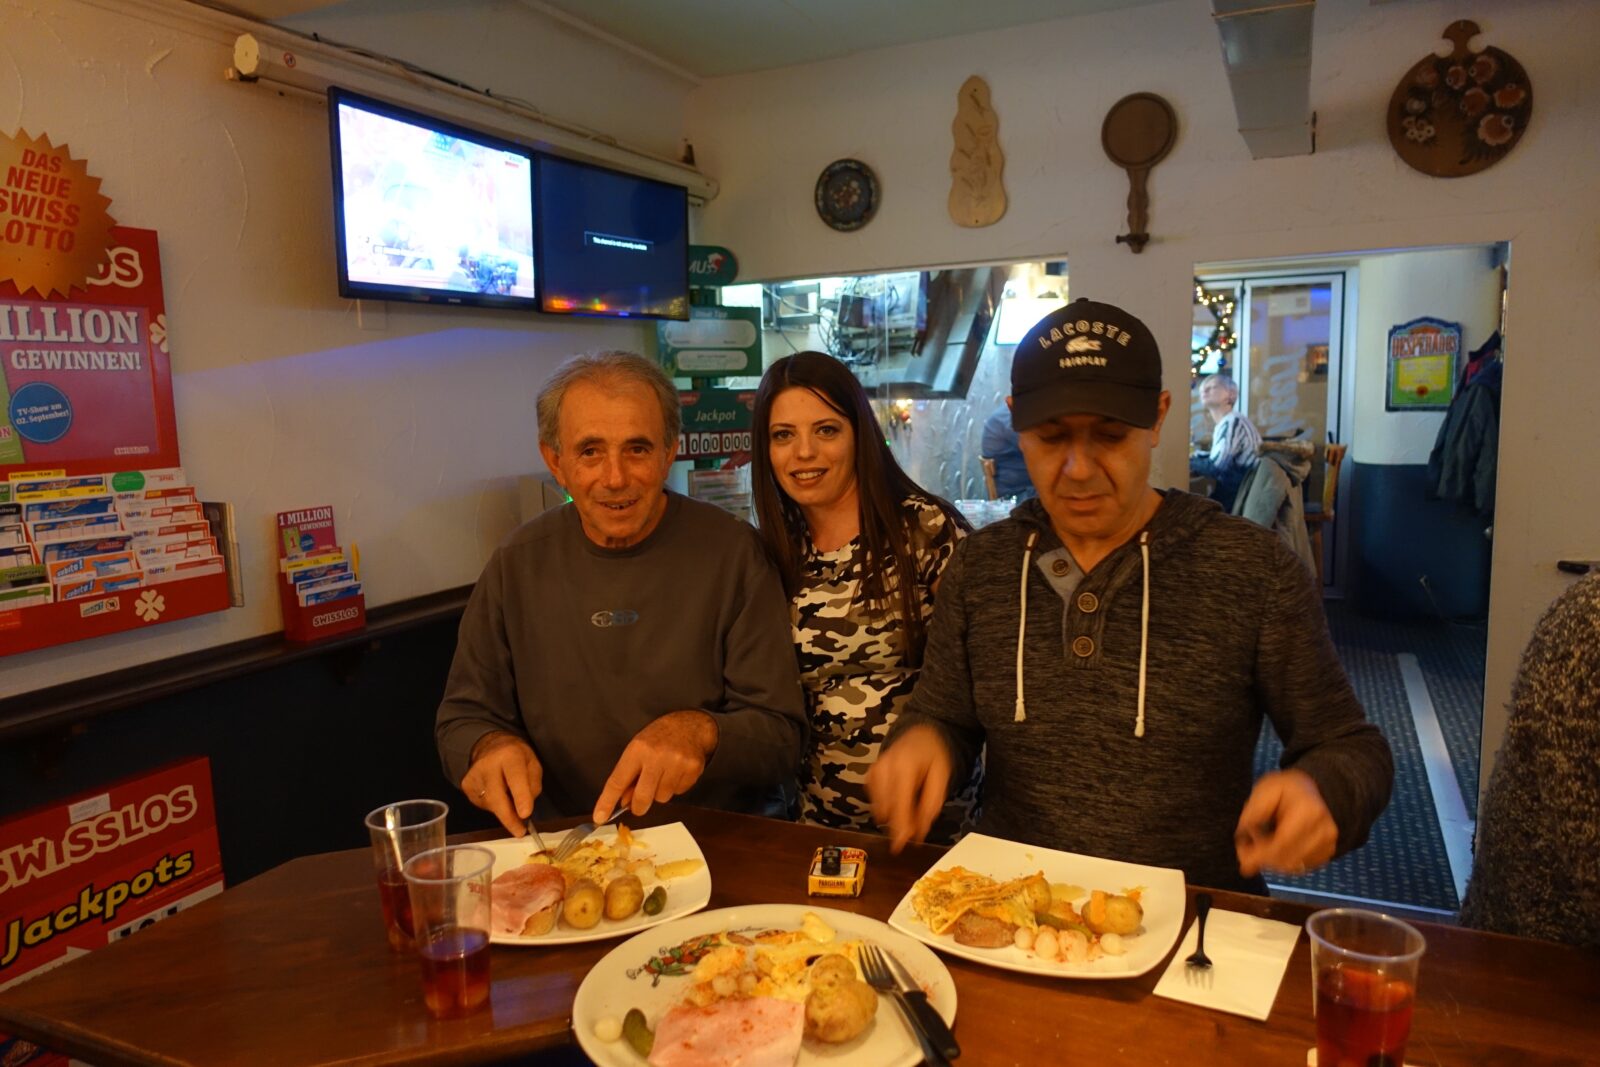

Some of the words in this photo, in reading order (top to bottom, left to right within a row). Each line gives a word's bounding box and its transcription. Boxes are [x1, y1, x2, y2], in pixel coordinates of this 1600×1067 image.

[22, 149, 62, 174] DAS
[7, 167, 72, 199] NEUE
[0, 219, 75, 253] OTTO
[0, 304, 138, 343] ILLION
[1038, 319, 1132, 350] LACOSTE
[11, 349, 141, 370] GEWINNEN!
[16, 405, 49, 416] TV-Show
[29, 409, 70, 423] September!
[695, 408, 736, 423] Jackpot
[279, 515, 286, 526] 1
[287, 508, 331, 524] MILLION
[313, 607, 358, 627] SWISSLOS
[0, 850, 194, 968] Jackpots
